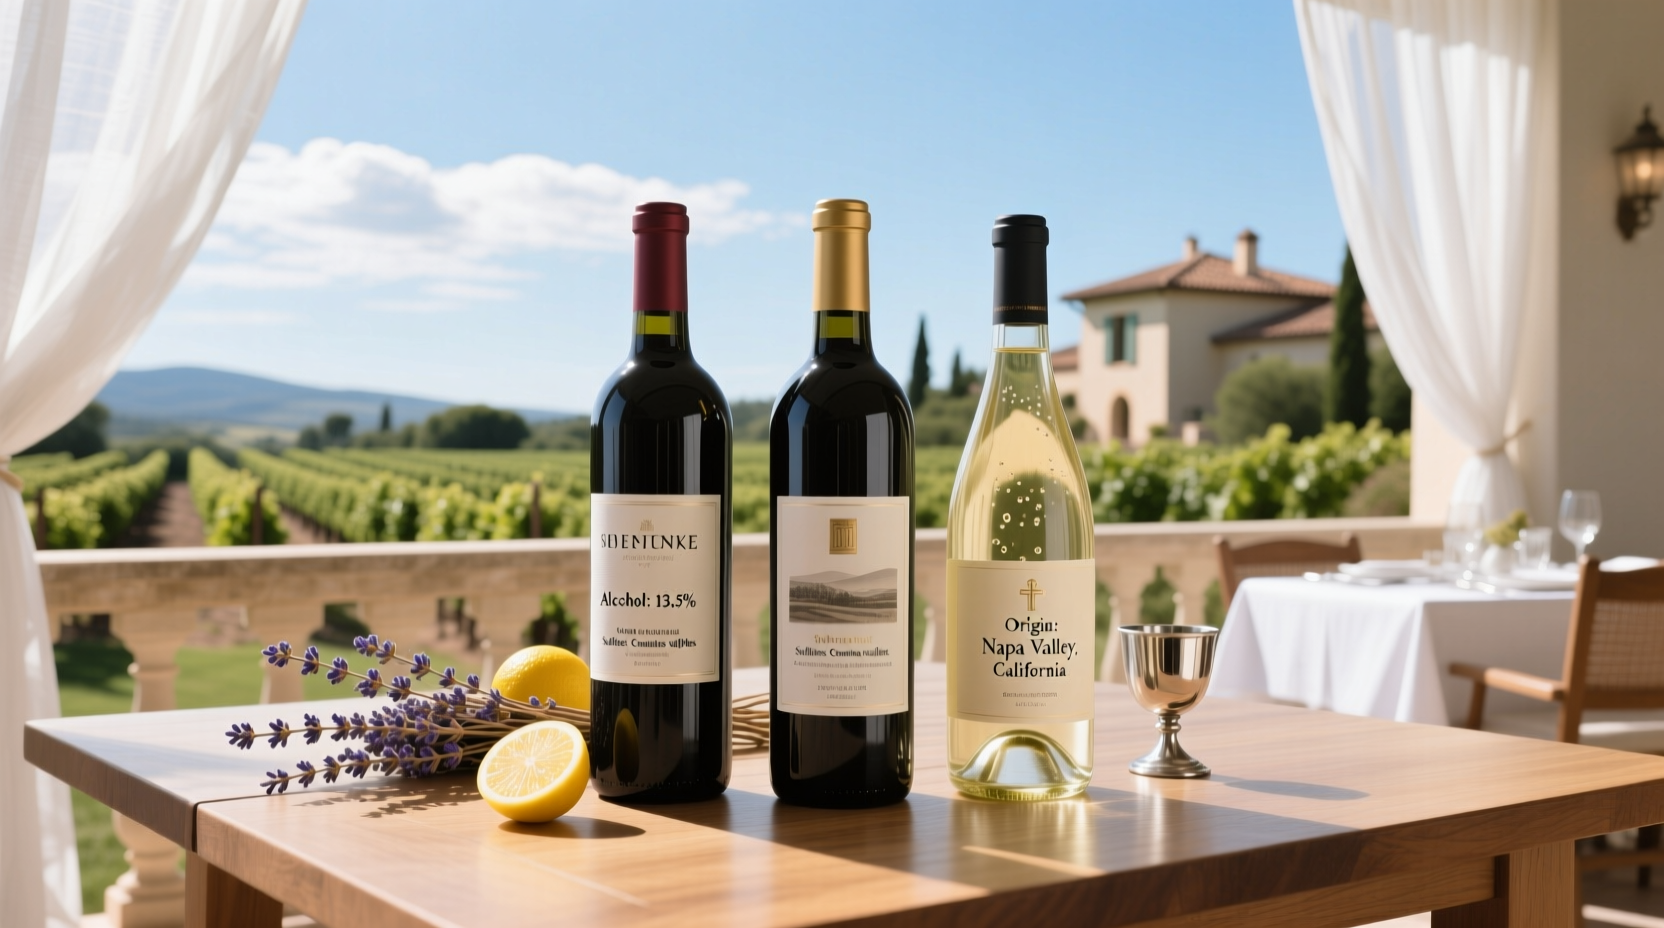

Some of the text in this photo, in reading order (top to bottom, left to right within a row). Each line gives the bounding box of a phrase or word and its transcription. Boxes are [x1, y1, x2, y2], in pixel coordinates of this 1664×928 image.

[600, 591, 697, 609] Alcohol: 13.5%
[1005, 616, 1058, 636] Origin:
[982, 637, 1025, 661] Napa
[993, 661, 1066, 677] California
